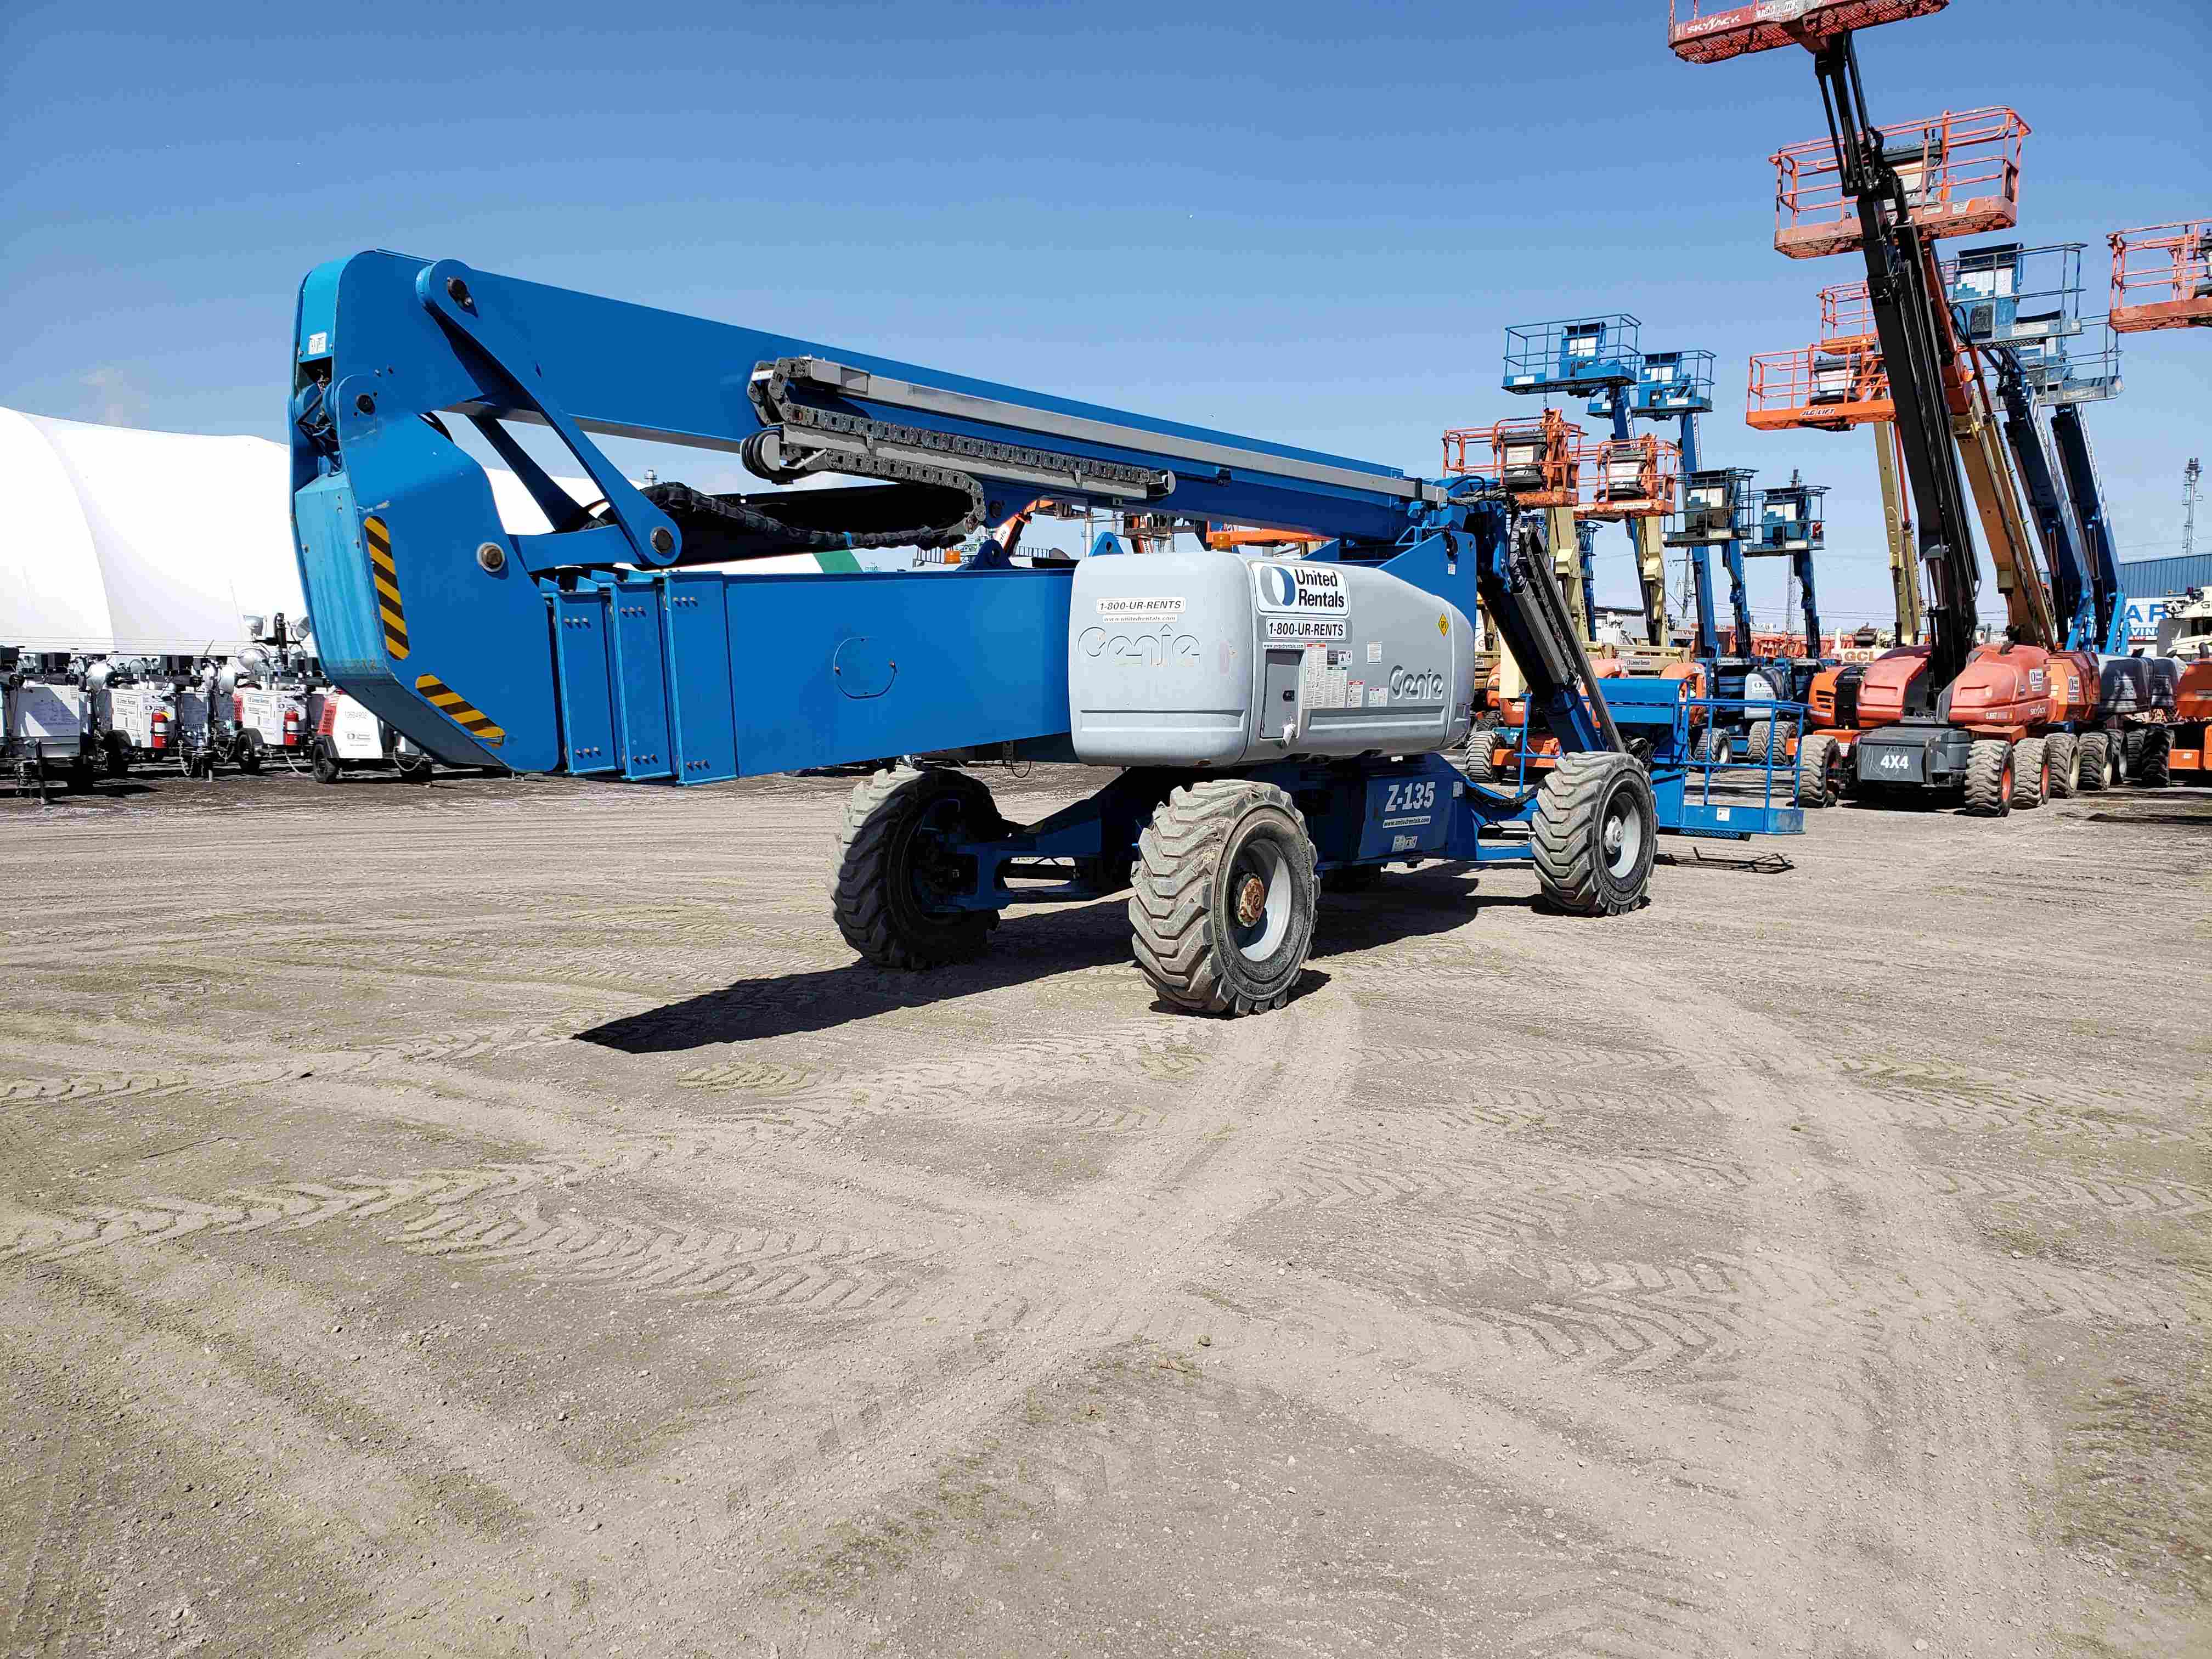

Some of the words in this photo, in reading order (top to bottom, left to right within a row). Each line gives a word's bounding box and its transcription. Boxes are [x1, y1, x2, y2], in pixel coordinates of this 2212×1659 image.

[1686, 15, 1741, 33] SKYJACK
[1295, 569, 1338, 586] United
[1099, 601, 1181, 610] 1-800-UR-RENTS
[1299, 589, 1344, 607] Rentals
[1269, 623, 1344, 636] 1-800-UR-RENTS
[1389, 665, 1444, 700] Genie
[1880, 755, 1909, 769] 4X4
[1385, 782, 1436, 812] Z-135
